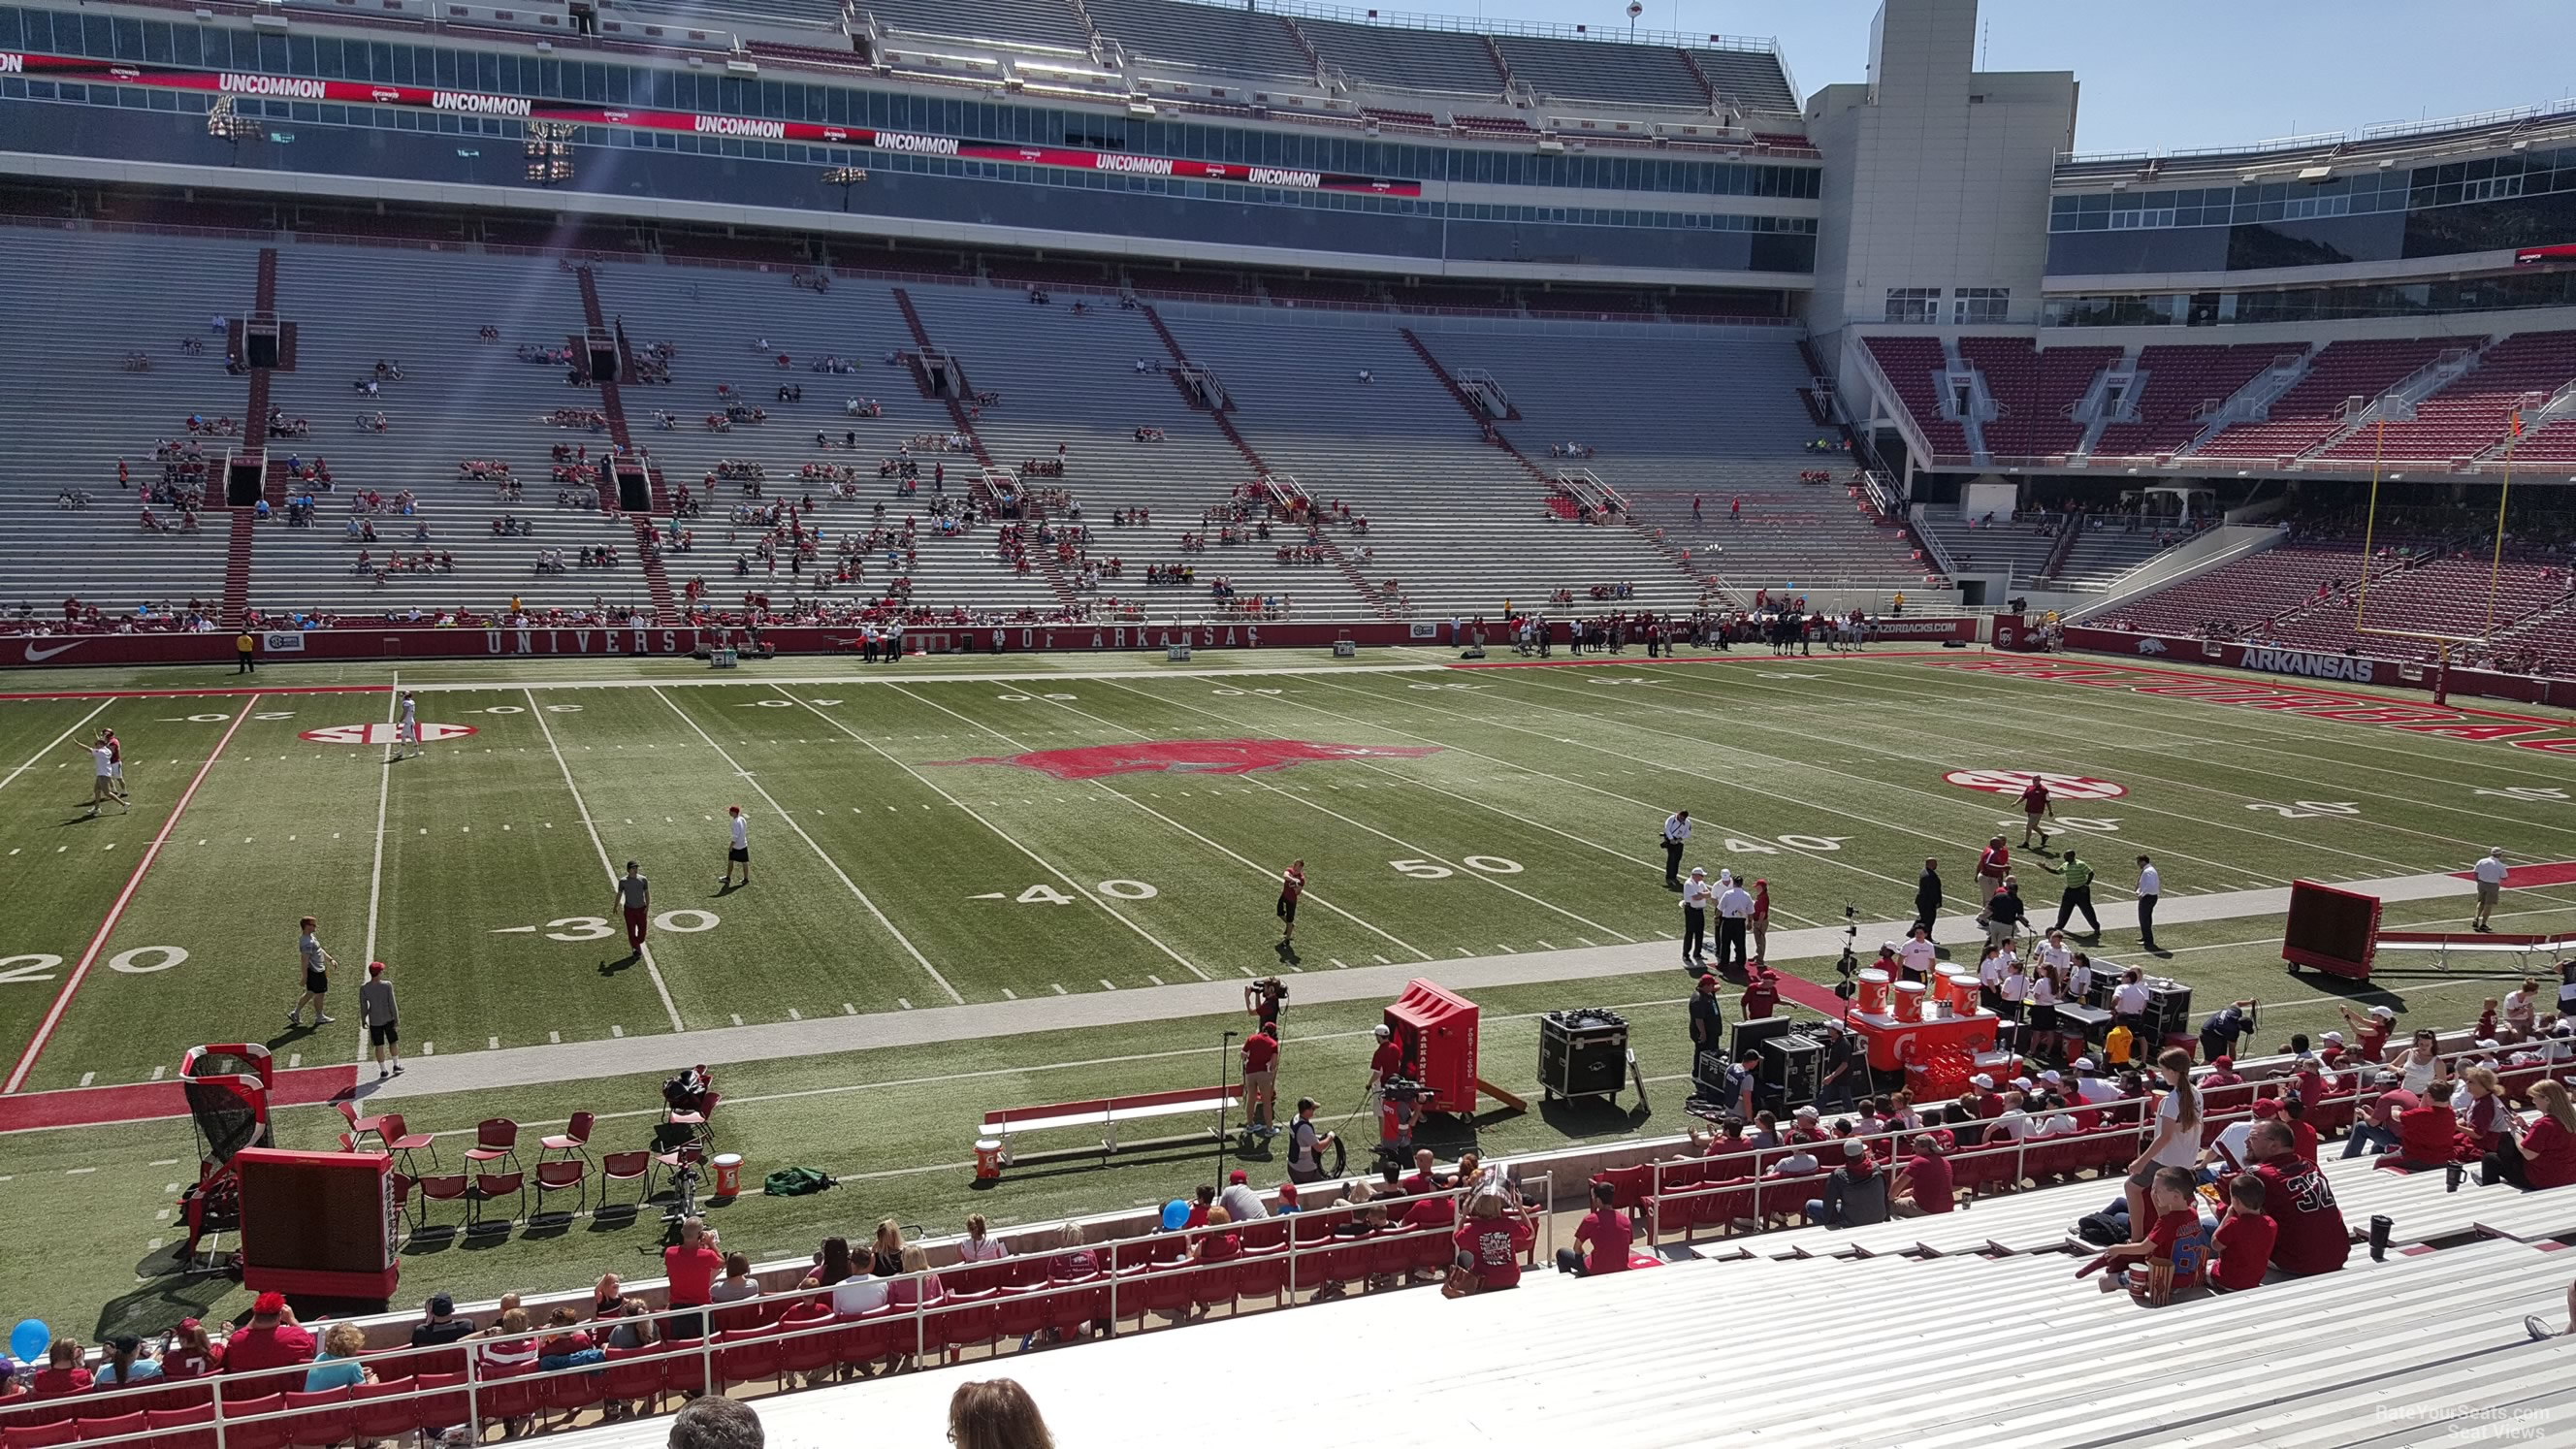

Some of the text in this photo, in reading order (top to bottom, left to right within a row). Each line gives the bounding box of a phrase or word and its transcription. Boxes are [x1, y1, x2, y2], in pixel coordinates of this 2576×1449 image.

[219, 73, 325, 99] UNCOMMON
[433, 91, 531, 116] UNCOMMON
[694, 114, 785, 139] UNCOMMON
[875, 132, 959, 155] UNCOMMON
[1096, 153, 1174, 176] UNCOMMON
[1248, 167, 1320, 188] UNCOMMON
[2240, 647, 2373, 682] ARKANSAS
[185, 1356, 206, 1375] 7
